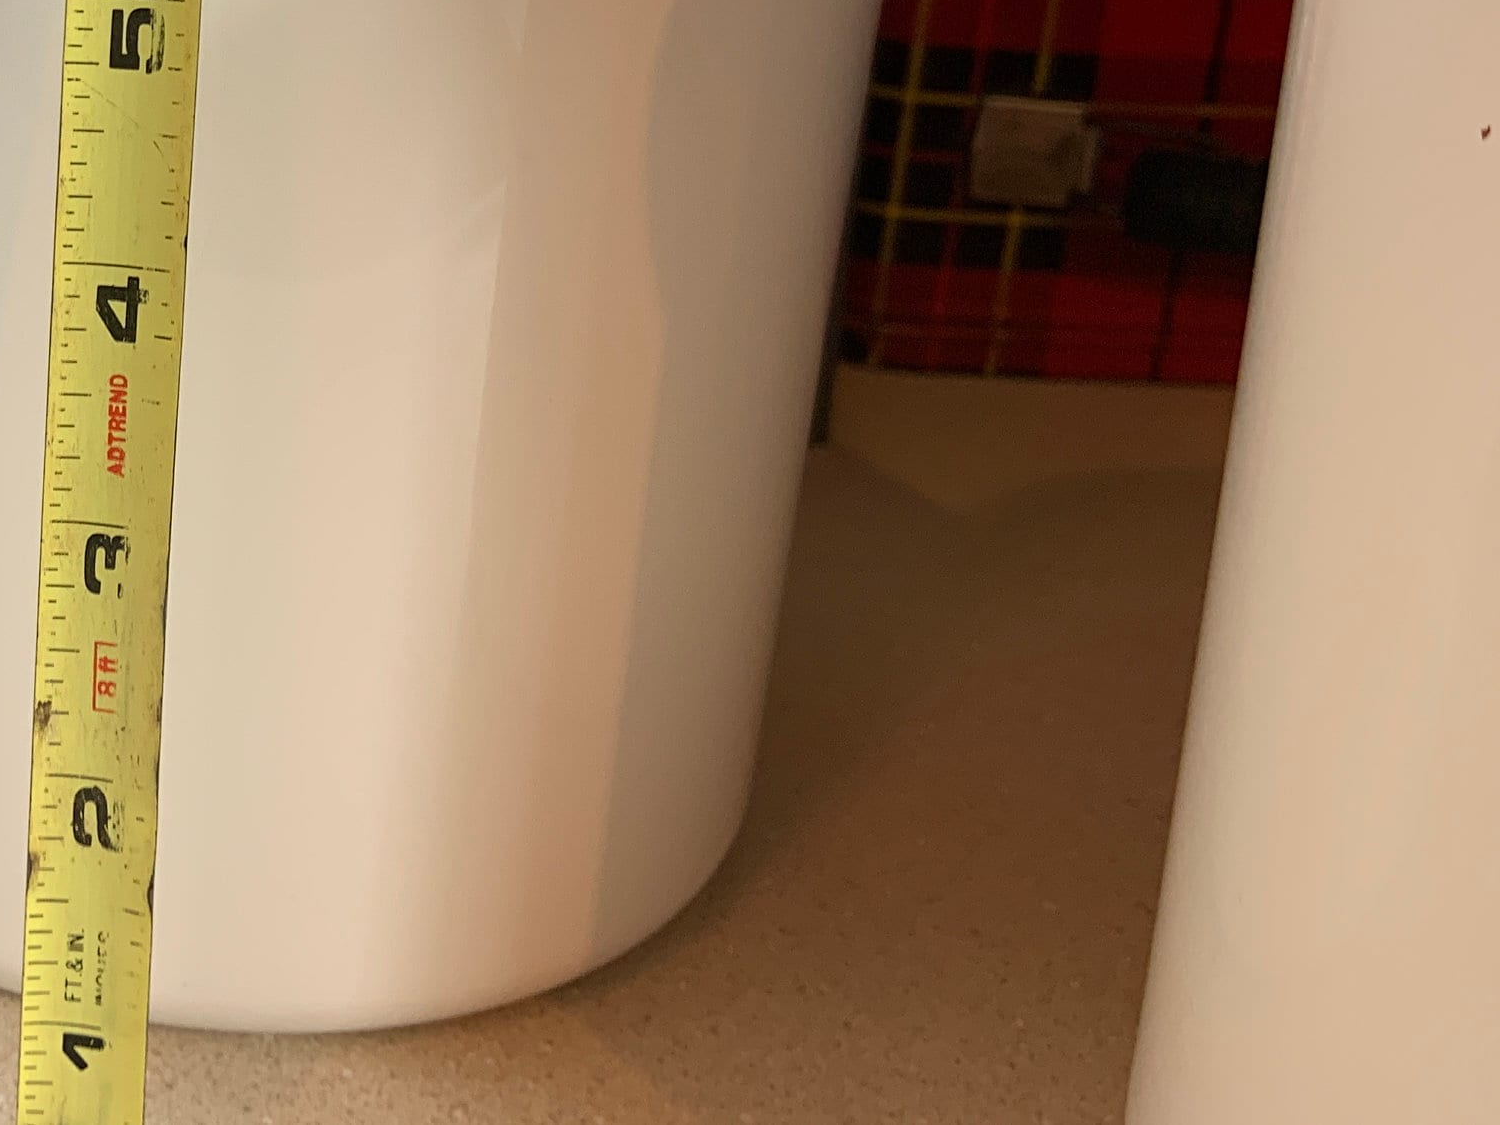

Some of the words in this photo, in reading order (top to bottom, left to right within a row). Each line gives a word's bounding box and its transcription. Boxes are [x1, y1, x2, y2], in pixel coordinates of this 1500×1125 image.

[109, 7, 166, 75] 5
[95, 275, 150, 343] 4
[106, 373, 129, 479] ADTREND
[84, 532, 132, 599] 3
[70, 784, 125, 854] 2
[62, 1032, 112, 1072] 1
